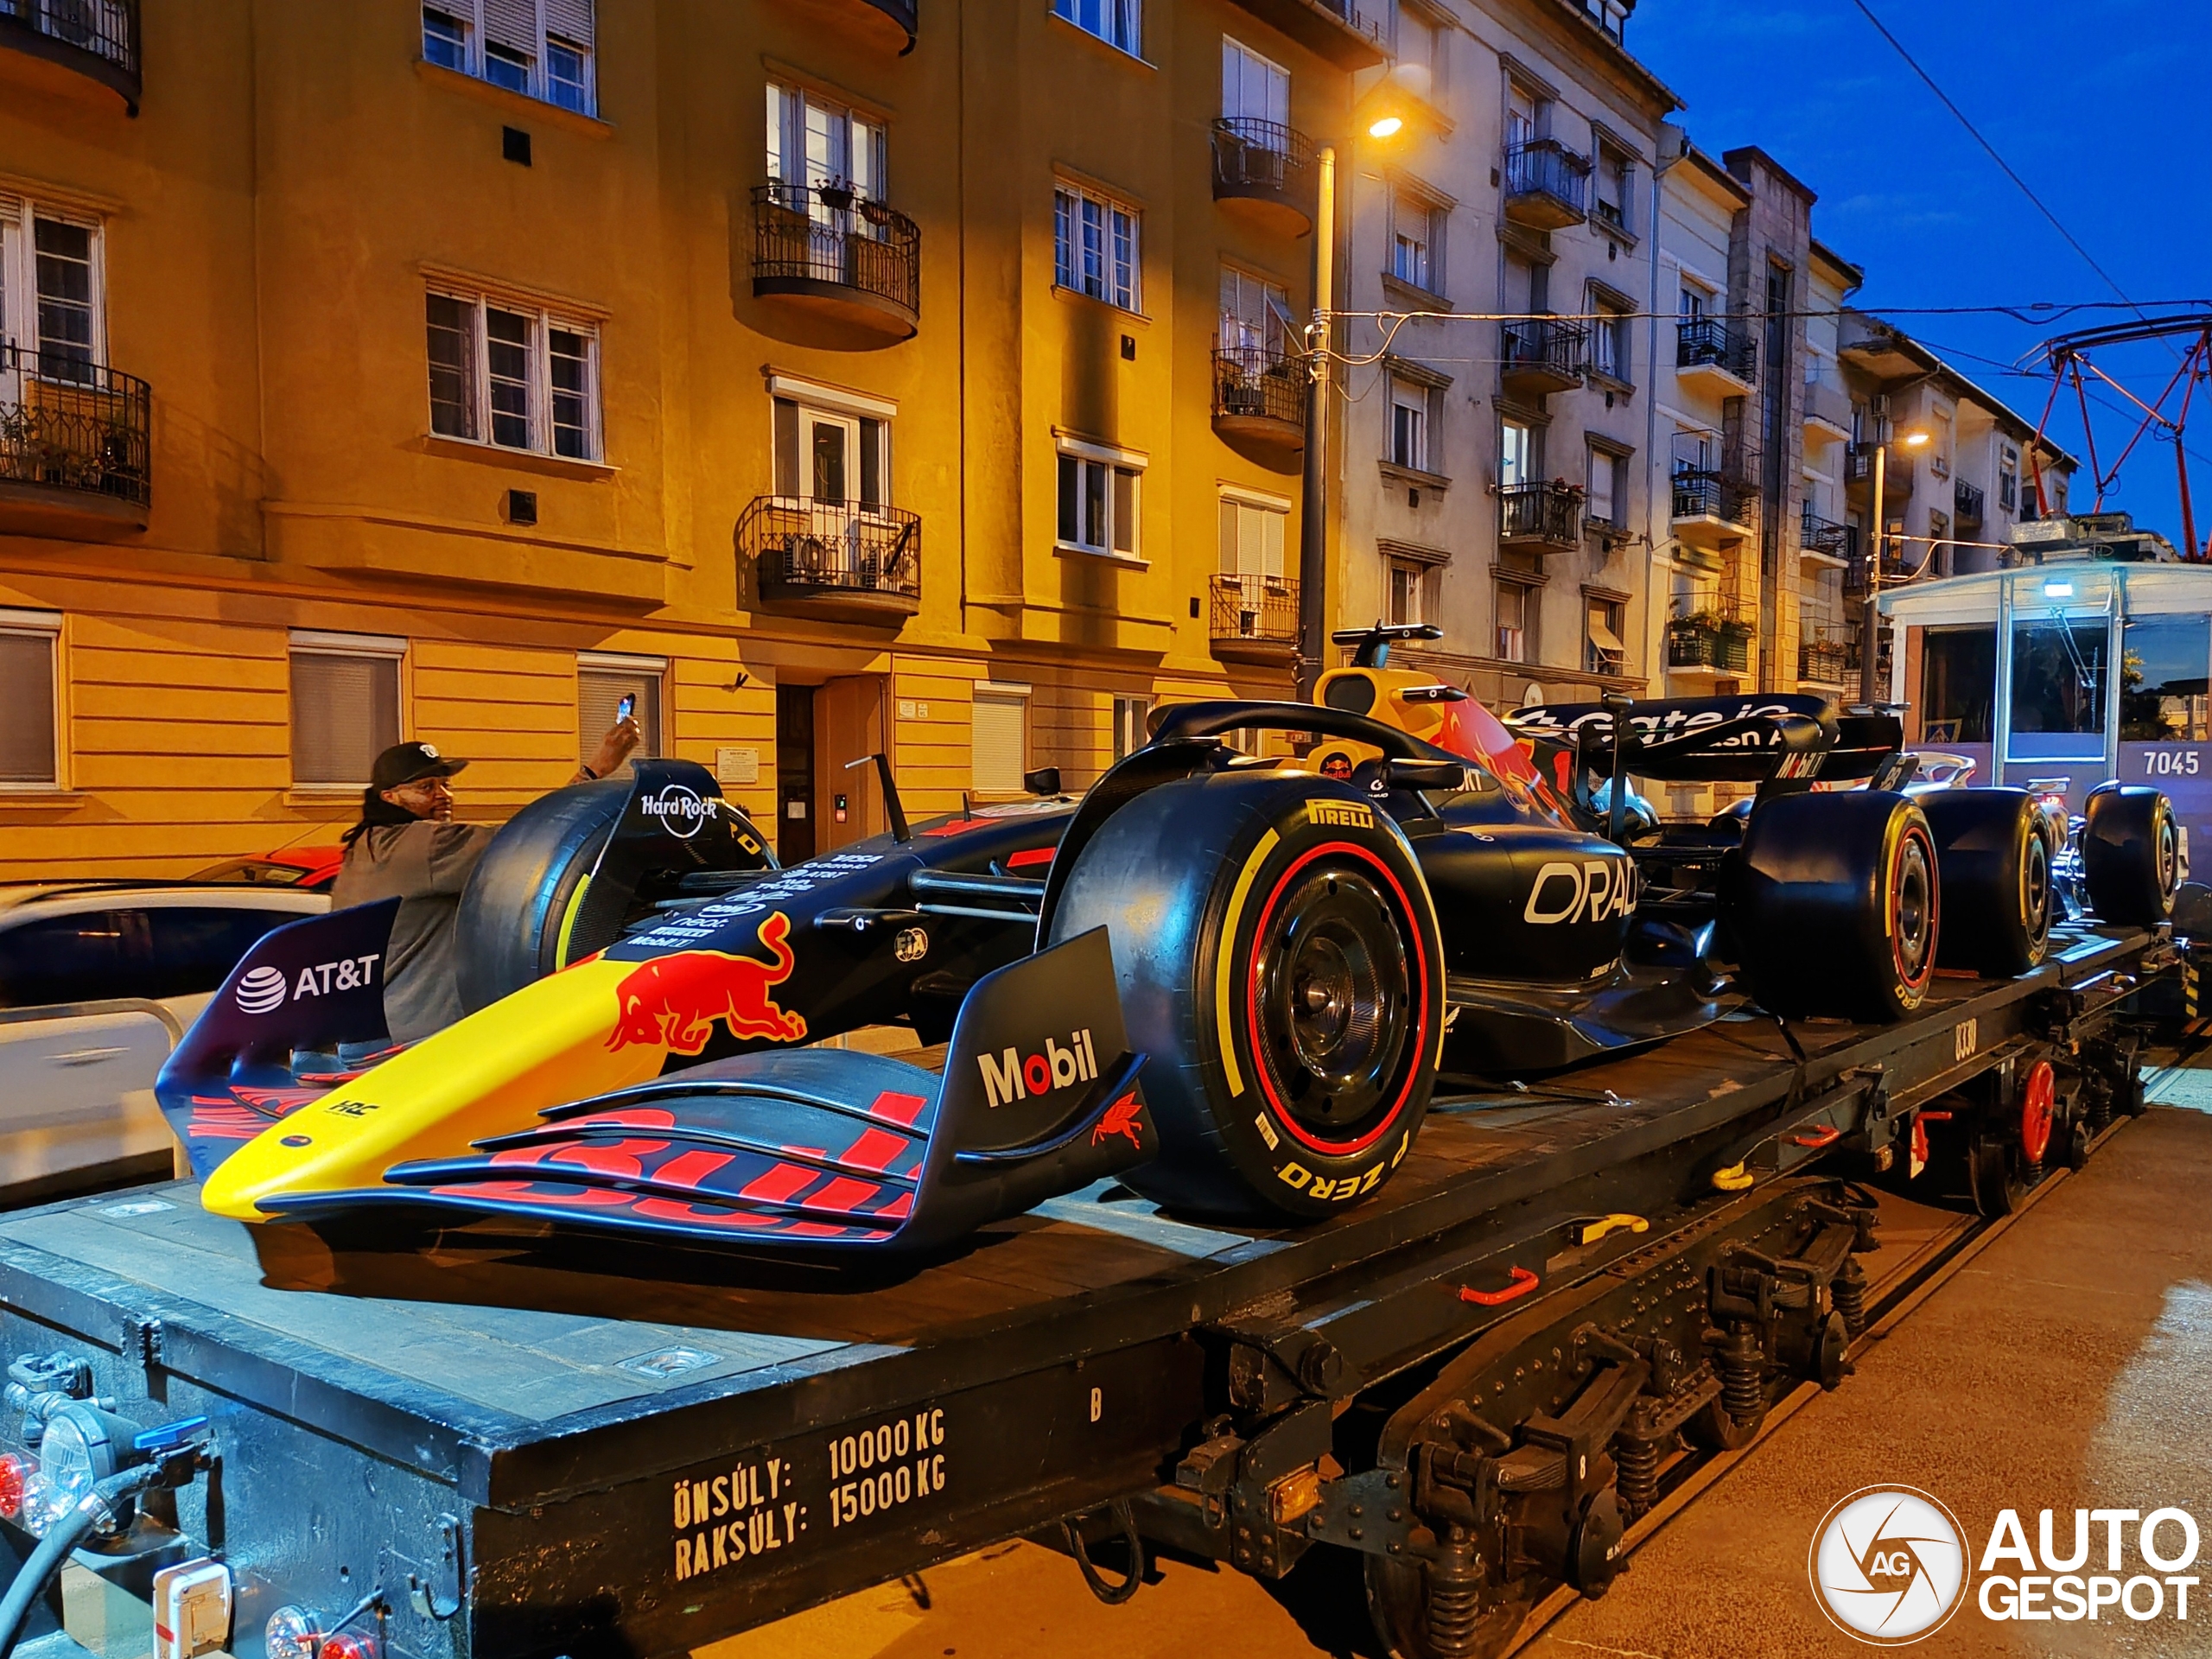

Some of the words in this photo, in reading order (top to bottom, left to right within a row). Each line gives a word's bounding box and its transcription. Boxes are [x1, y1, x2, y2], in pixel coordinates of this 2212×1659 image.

[1776, 753, 1810, 779] Mobil
[2144, 751, 2199, 774] 7045
[641, 795, 679, 816] Hard
[679, 796, 717, 820] Rock
[1305, 798, 1375, 830] PIRELLI
[830, 854, 884, 862] VISA
[1524, 855, 1637, 924] ORAC
[627, 936, 679, 947] Mobil
[293, 954, 379, 1001] AT&T
[1955, 1018, 1977, 1061] 8330
[976, 1028, 1098, 1109] Mobil
[1391, 1128, 1409, 1169] P
[1277, 1161, 1384, 1201] ZERO
[1090, 1388, 1102, 1422] B
[673, 1458, 791, 1529] ÖNSÚLY:
[829, 1420, 909, 1480] 10000
[916, 1408, 944, 1452] KG
[675, 1501, 807, 1581] RAKSÚLY:
[830, 1465, 911, 1528] 15000
[918, 1454, 945, 1498] KG
